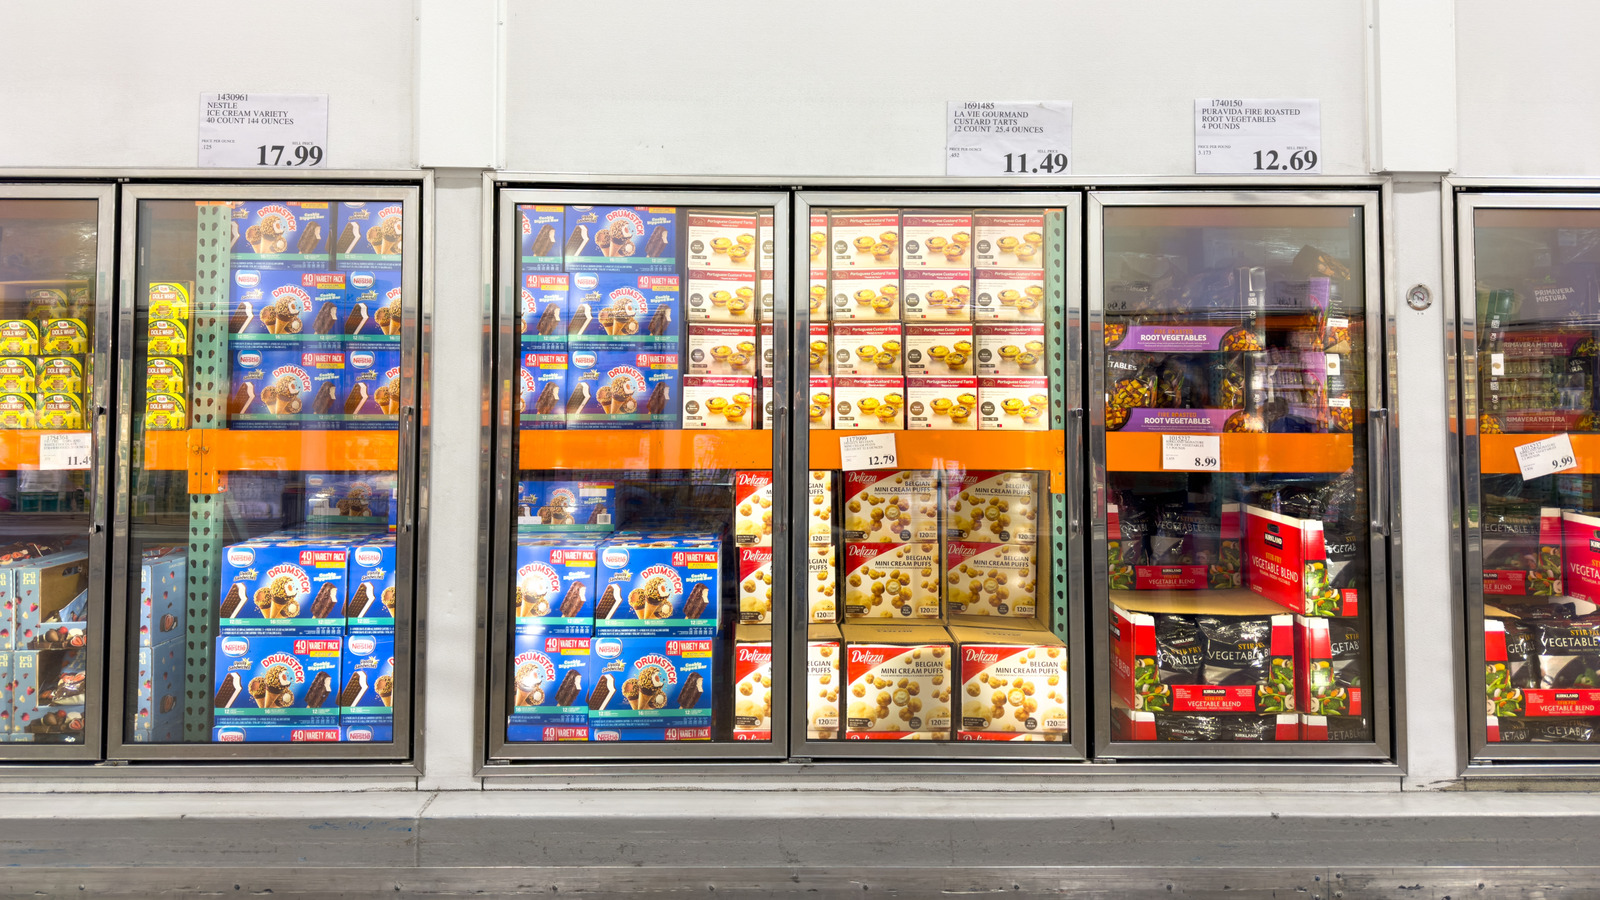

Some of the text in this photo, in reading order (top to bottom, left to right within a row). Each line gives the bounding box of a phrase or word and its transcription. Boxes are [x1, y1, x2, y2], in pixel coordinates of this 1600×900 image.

[217, 93, 248, 101] 1430961
[257, 145, 323, 166] 17.99
[1254, 150, 1318, 171] 12.69
[1004, 153, 1068, 174] 11.49
[257, 205, 296, 231] DRUMSTICK
[606, 209, 645, 235] DRUMSTICK
[303, 274, 343, 282] 40 VARIETY PACK
[1534, 287, 1575, 296] PRIMAVERA
[1536, 294, 1567, 302] MISTURA
[272, 286, 312, 312] DRUMSTICK
[610, 288, 648, 314] DRUMSTICK
[608, 366, 646, 392] DRUMSTICK
[869, 455, 895, 466] 12.79
[1194, 457, 1217, 467] 8.99
[1552, 456, 1573, 469] 9.99
[848, 472, 876, 483] Delizza
[1265, 533, 1282, 544] KIRKLAND
[301, 552, 344, 560] 40 VARIETY PACK
[673, 553, 716, 562] 40 VARIETY PACK
[849, 546, 878, 556] Delizza
[1252, 555, 1298, 582] VEGETABLE BLEND
[268, 564, 310, 594] DRUMSTICK
[641, 566, 684, 594] DRUMSTICK
[295, 640, 339, 650] 40 VARIETY PACK
[667, 642, 710, 650] 40 VARIETY PACK
[1541, 637, 1598, 648] VEGETABLE
[740, 648, 772, 663] Delizza
[852, 650, 884, 664] Delizza
[966, 649, 997, 662] Delizza
[1208, 650, 1262, 661] VEGETABLE
[261, 654, 304, 683] DRUMSTICK
[634, 656, 677, 684] DRUMSTICK
